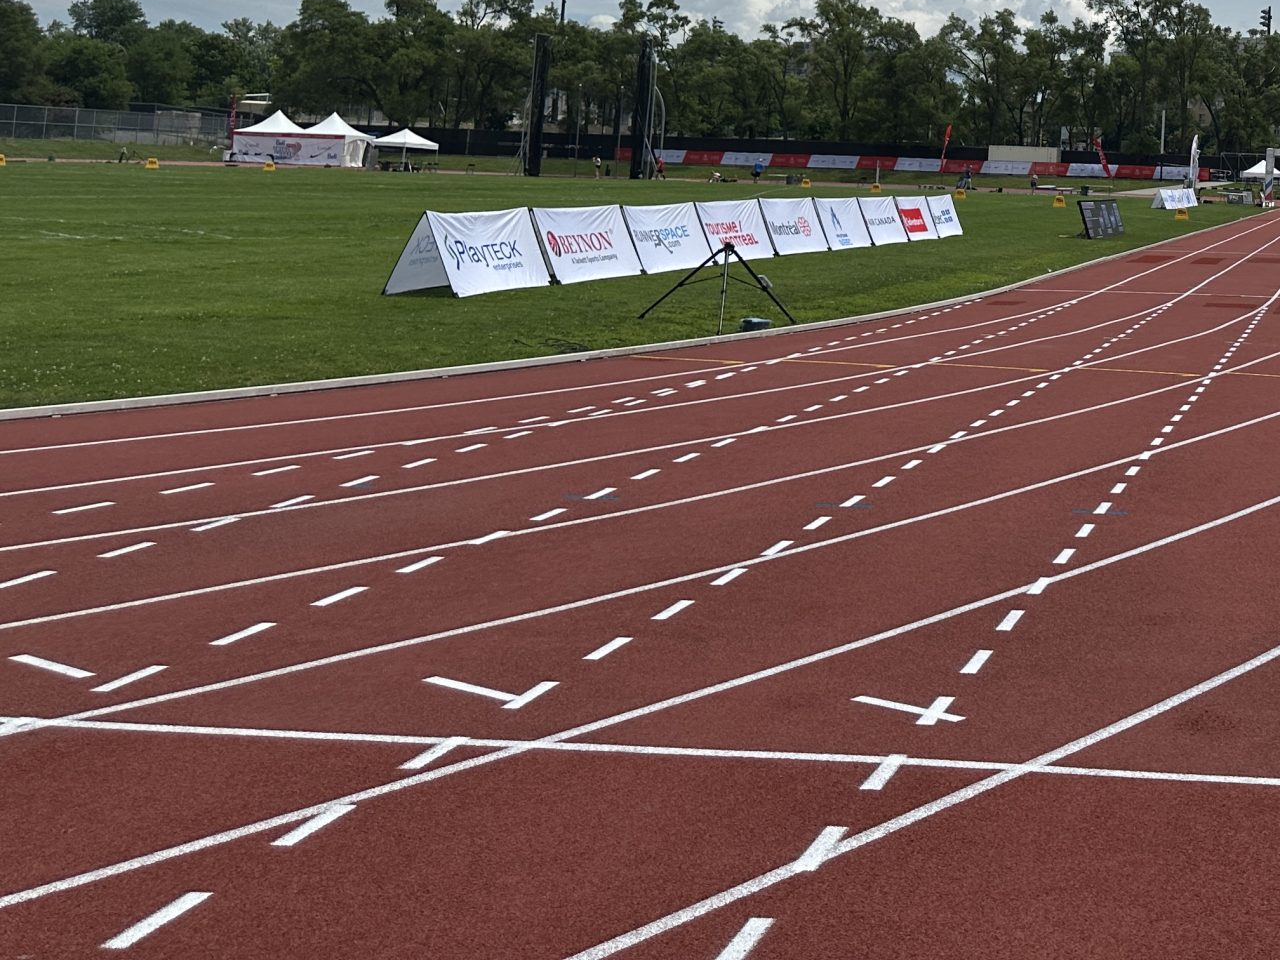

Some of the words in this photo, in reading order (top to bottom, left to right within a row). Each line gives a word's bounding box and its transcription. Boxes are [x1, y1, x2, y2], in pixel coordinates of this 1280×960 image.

[769, 221, 801, 236] Montréal
[874, 216, 896, 226] CANADA
[557, 231, 614, 254] BEYNON
